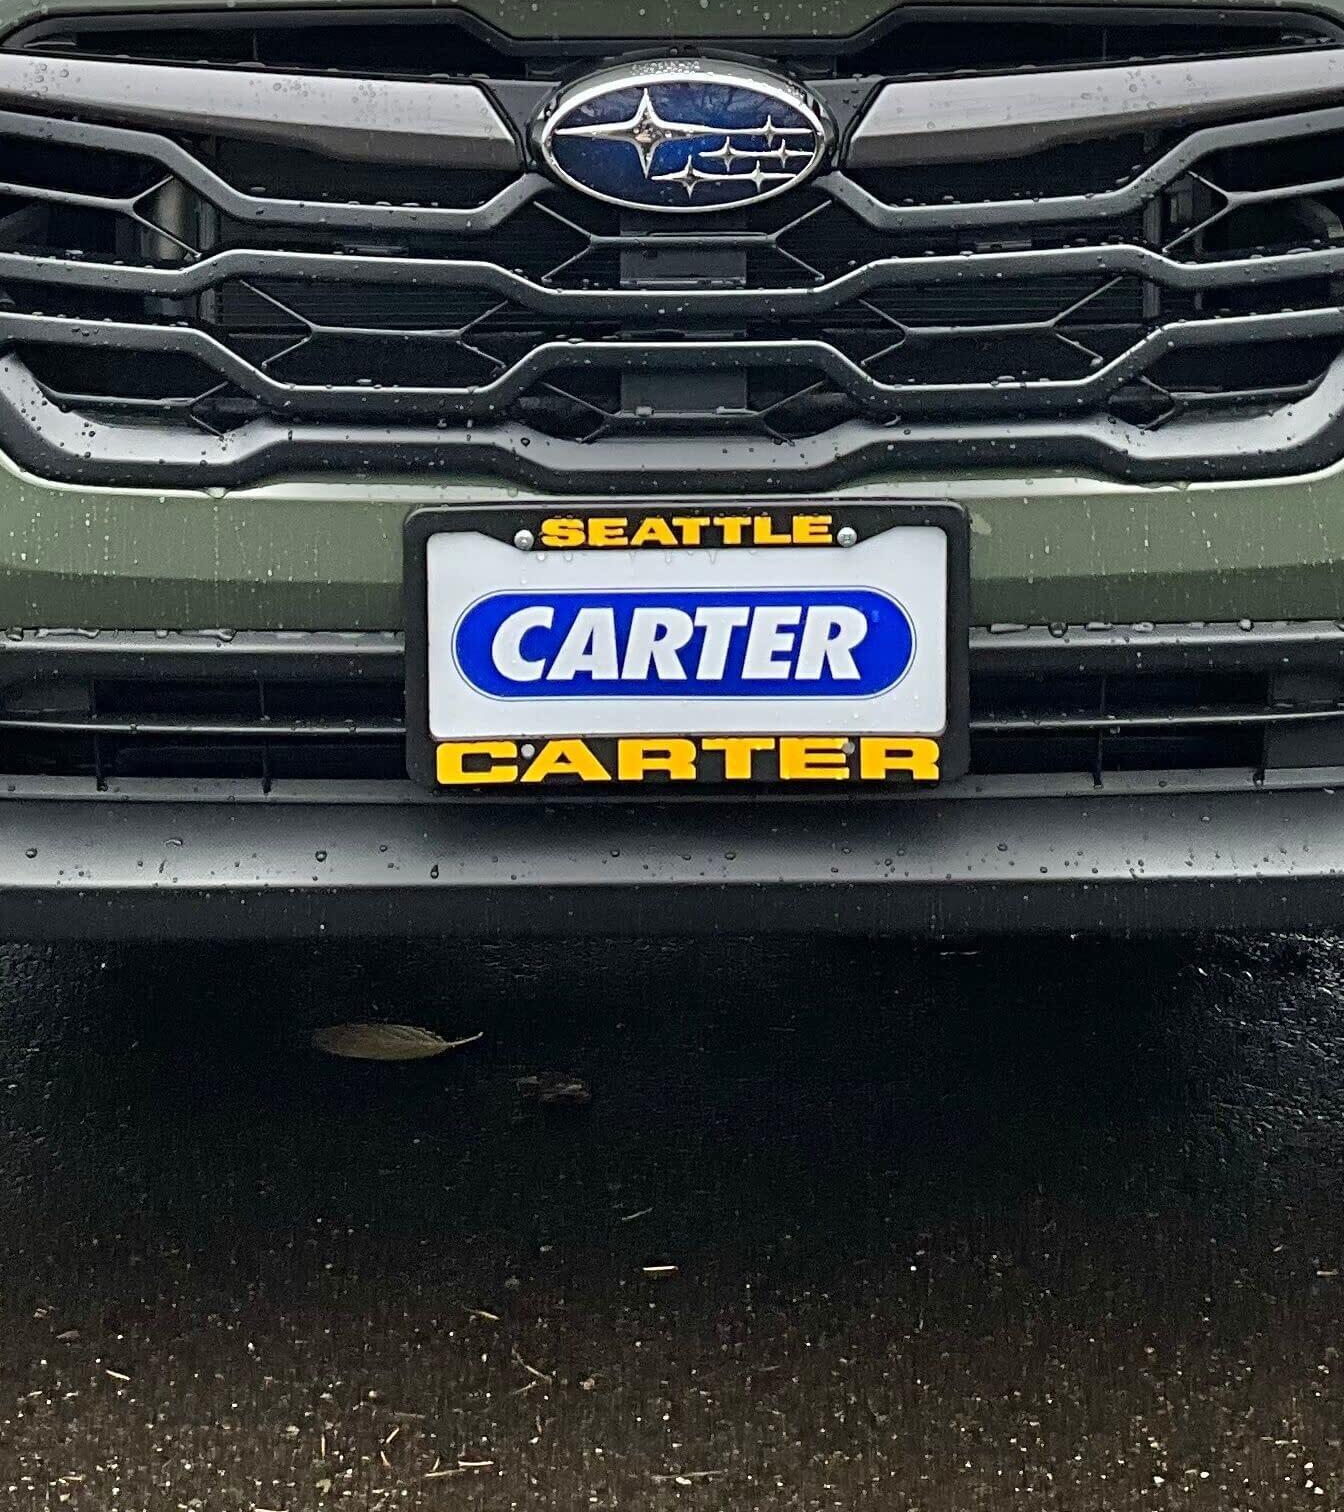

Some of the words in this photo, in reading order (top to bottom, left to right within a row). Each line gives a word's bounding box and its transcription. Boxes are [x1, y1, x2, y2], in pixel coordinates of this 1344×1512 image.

[541, 515, 833, 547] SEATTLE
[490, 605, 869, 682] CARTER
[436, 737, 940, 785] CARTER
